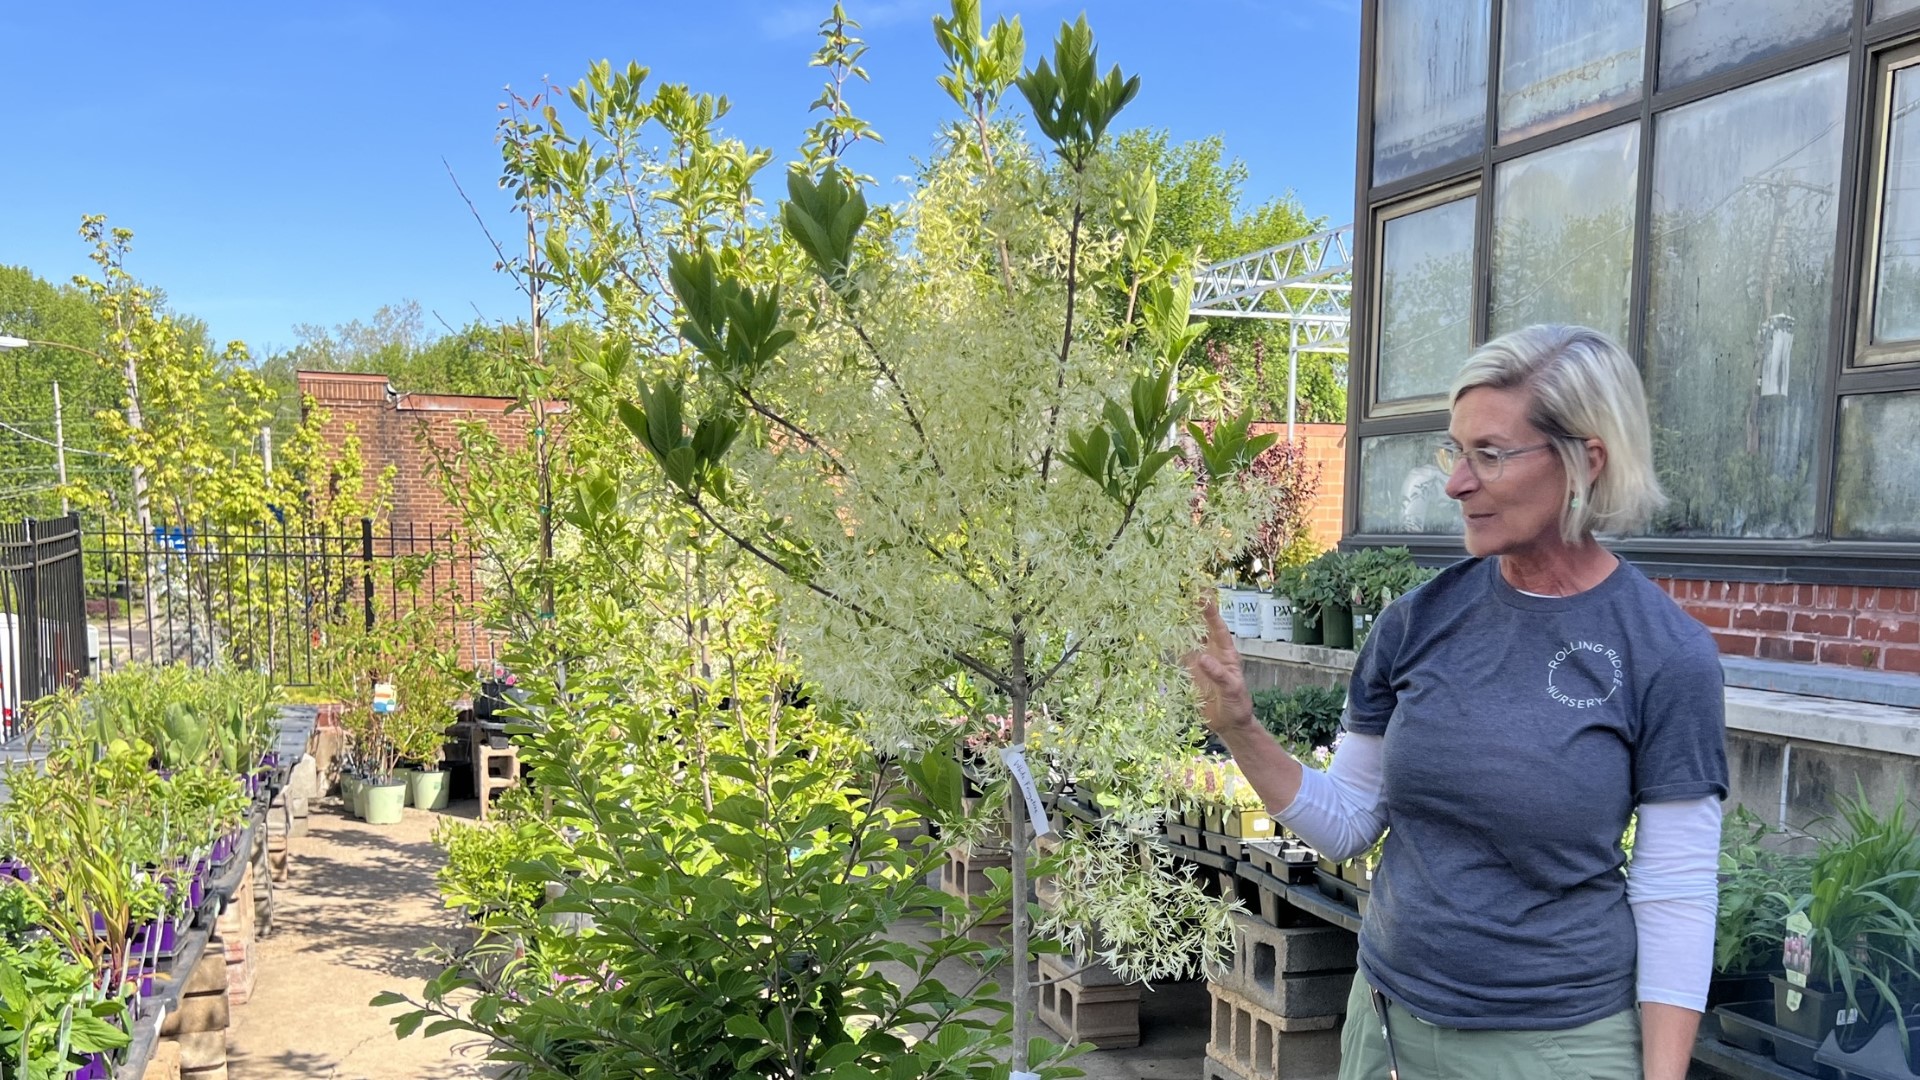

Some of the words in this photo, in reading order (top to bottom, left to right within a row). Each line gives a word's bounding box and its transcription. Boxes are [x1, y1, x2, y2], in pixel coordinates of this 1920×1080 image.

[1238, 602, 1258, 613] PW
[1548, 641, 1604, 670] ROLLING
[1604, 649, 1623, 687] RIDGE
[1546, 685, 1602, 709] NURSERY
